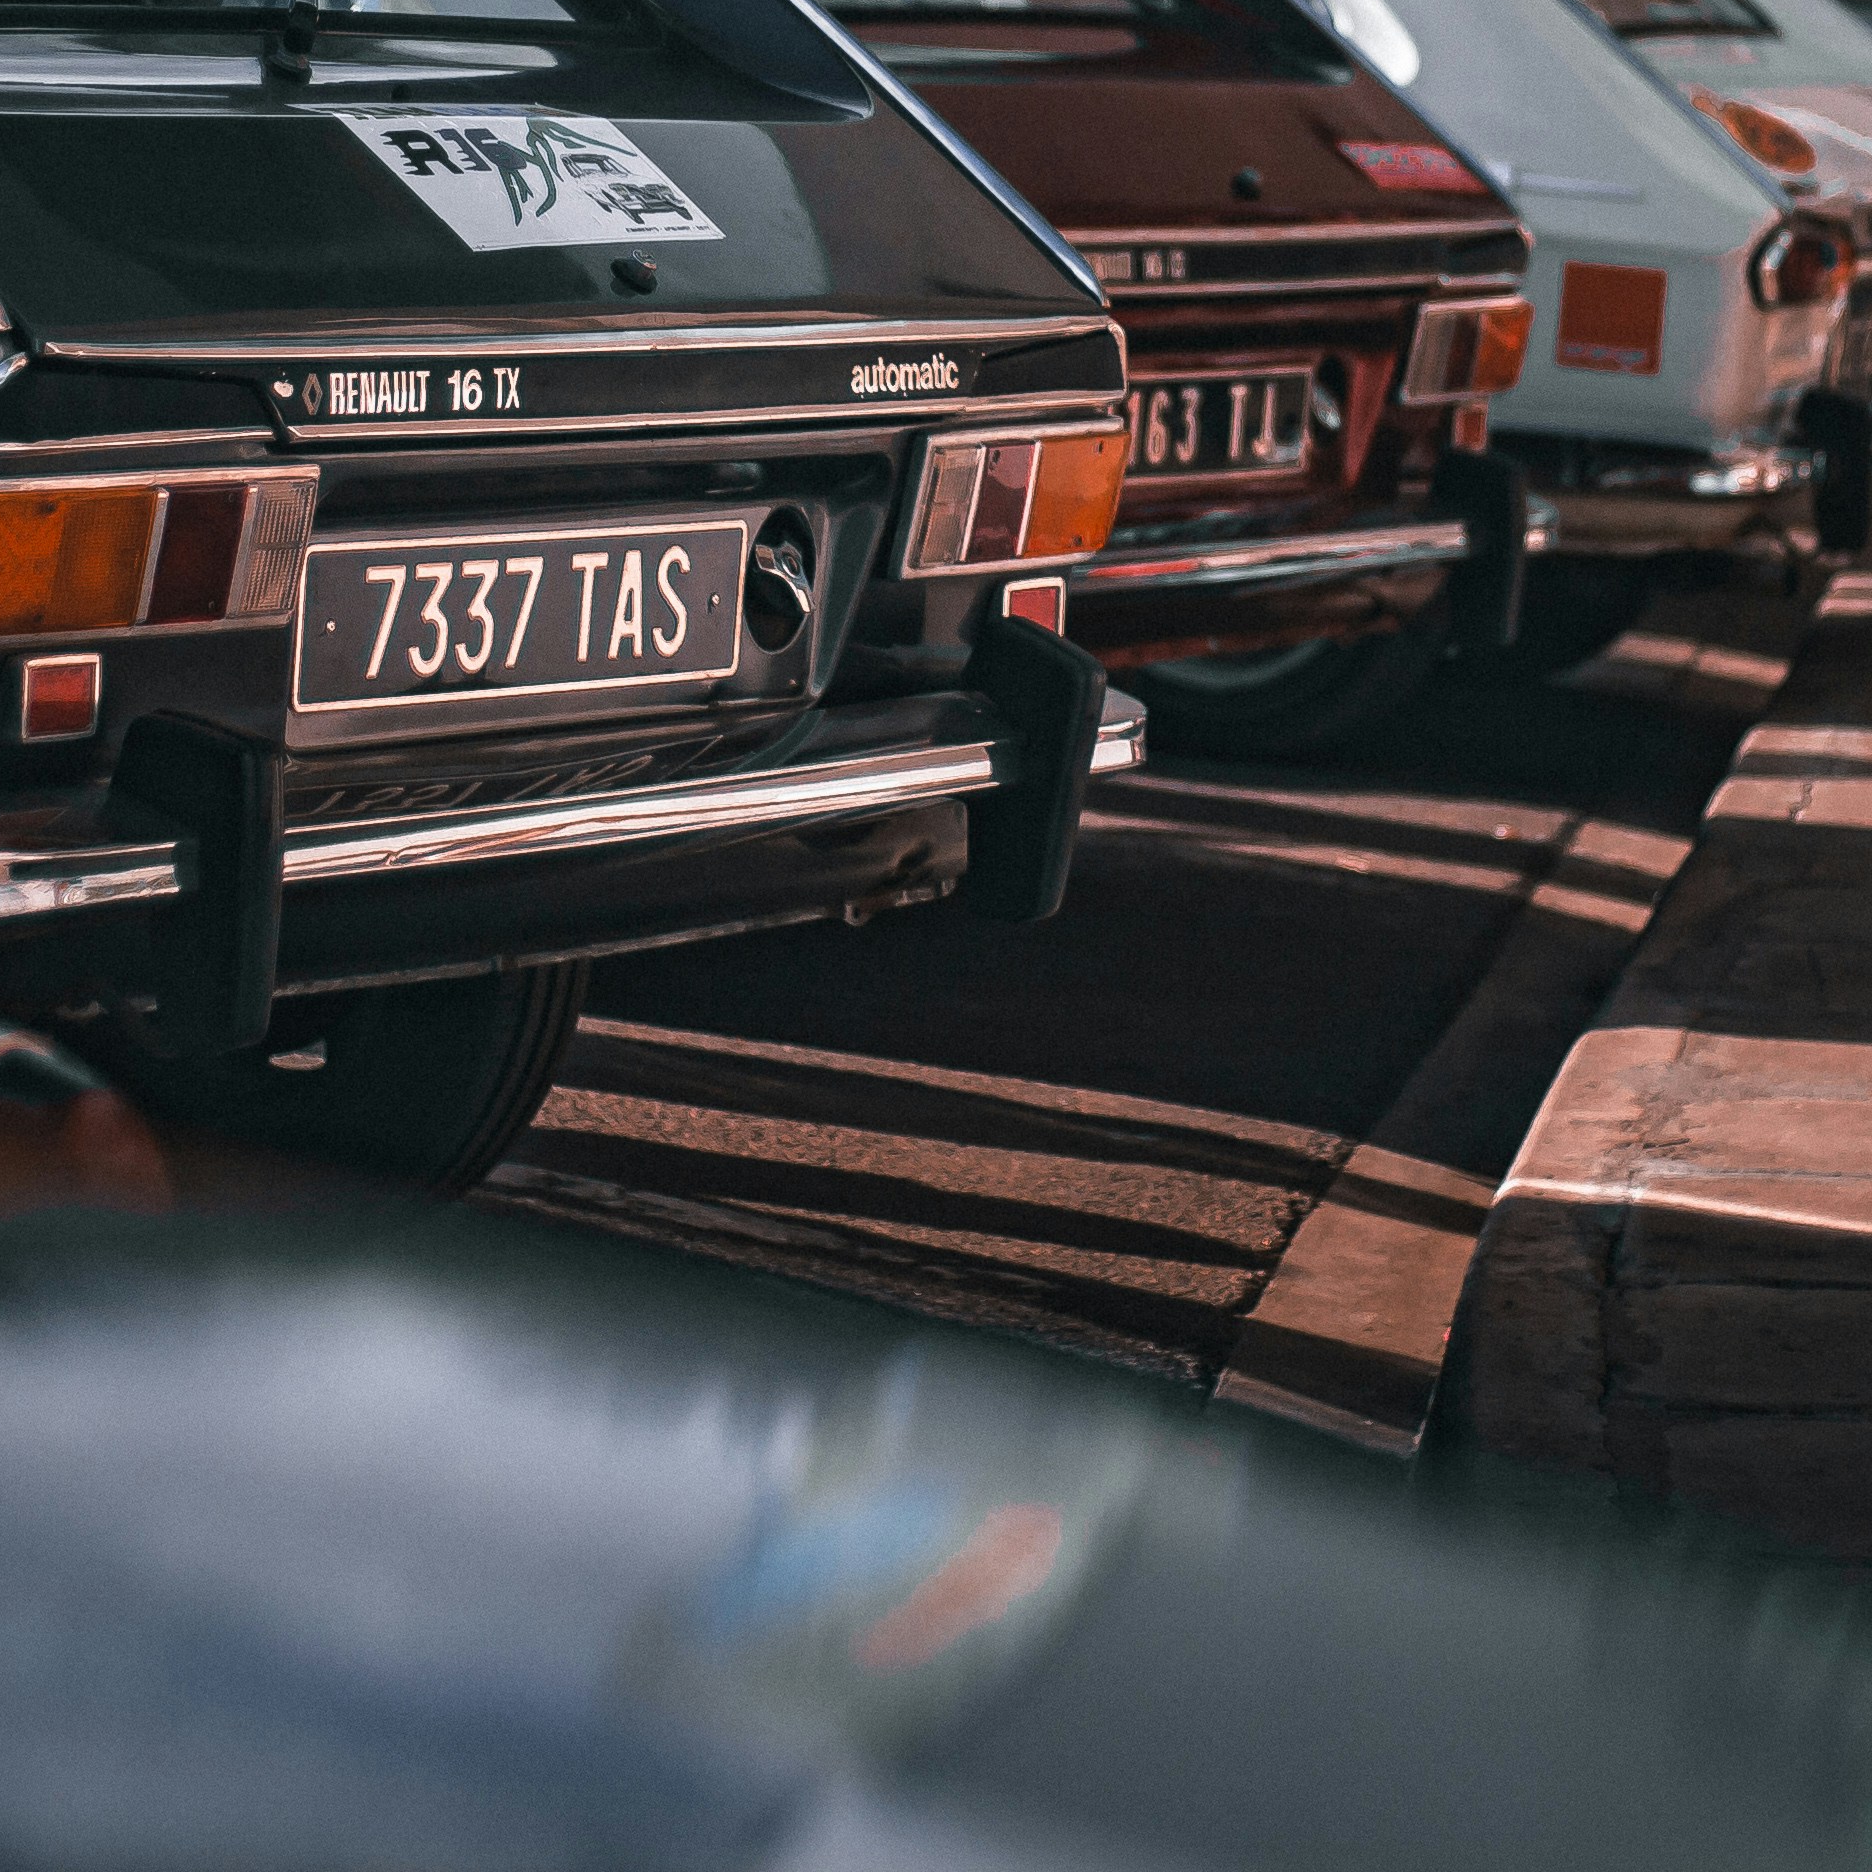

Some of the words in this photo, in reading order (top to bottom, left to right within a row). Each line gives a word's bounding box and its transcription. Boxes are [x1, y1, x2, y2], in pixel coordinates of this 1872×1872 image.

[329, 370, 431, 415] RENAULT
[447, 368, 483, 411] 16
[493, 367, 520, 410] TX
[850, 352, 960, 394] automatic
[365, 556, 545, 680] 7337
[571, 545, 692, 663] TAS
